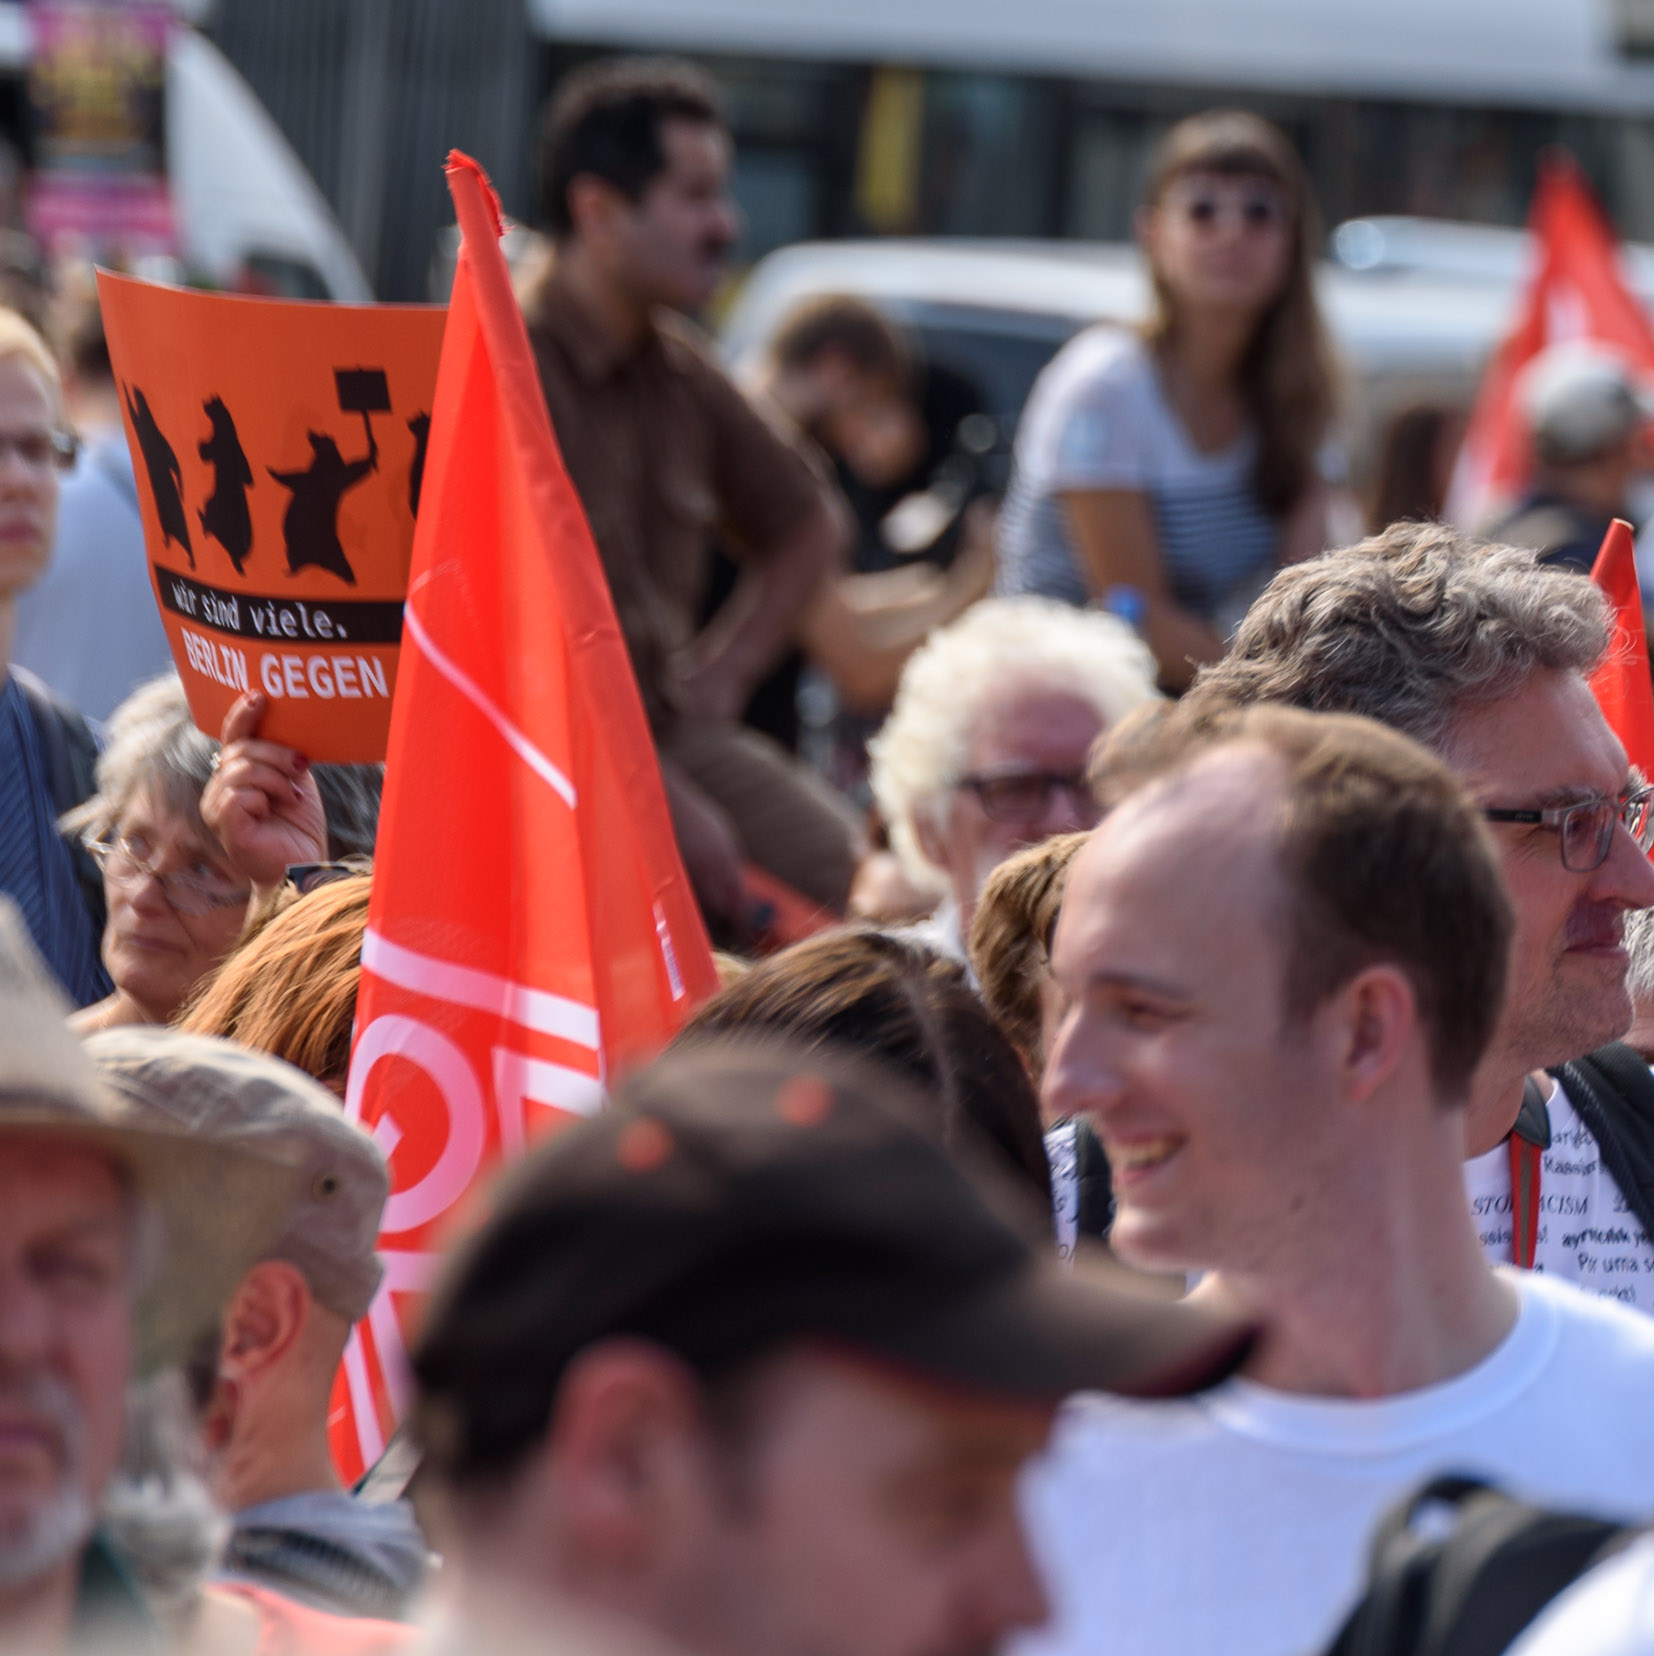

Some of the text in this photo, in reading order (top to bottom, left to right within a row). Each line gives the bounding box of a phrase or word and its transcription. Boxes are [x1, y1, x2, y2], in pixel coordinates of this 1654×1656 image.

[171, 579, 347, 639] wir sind viele.
[181, 627, 389, 699] BERLIN GEGEN
